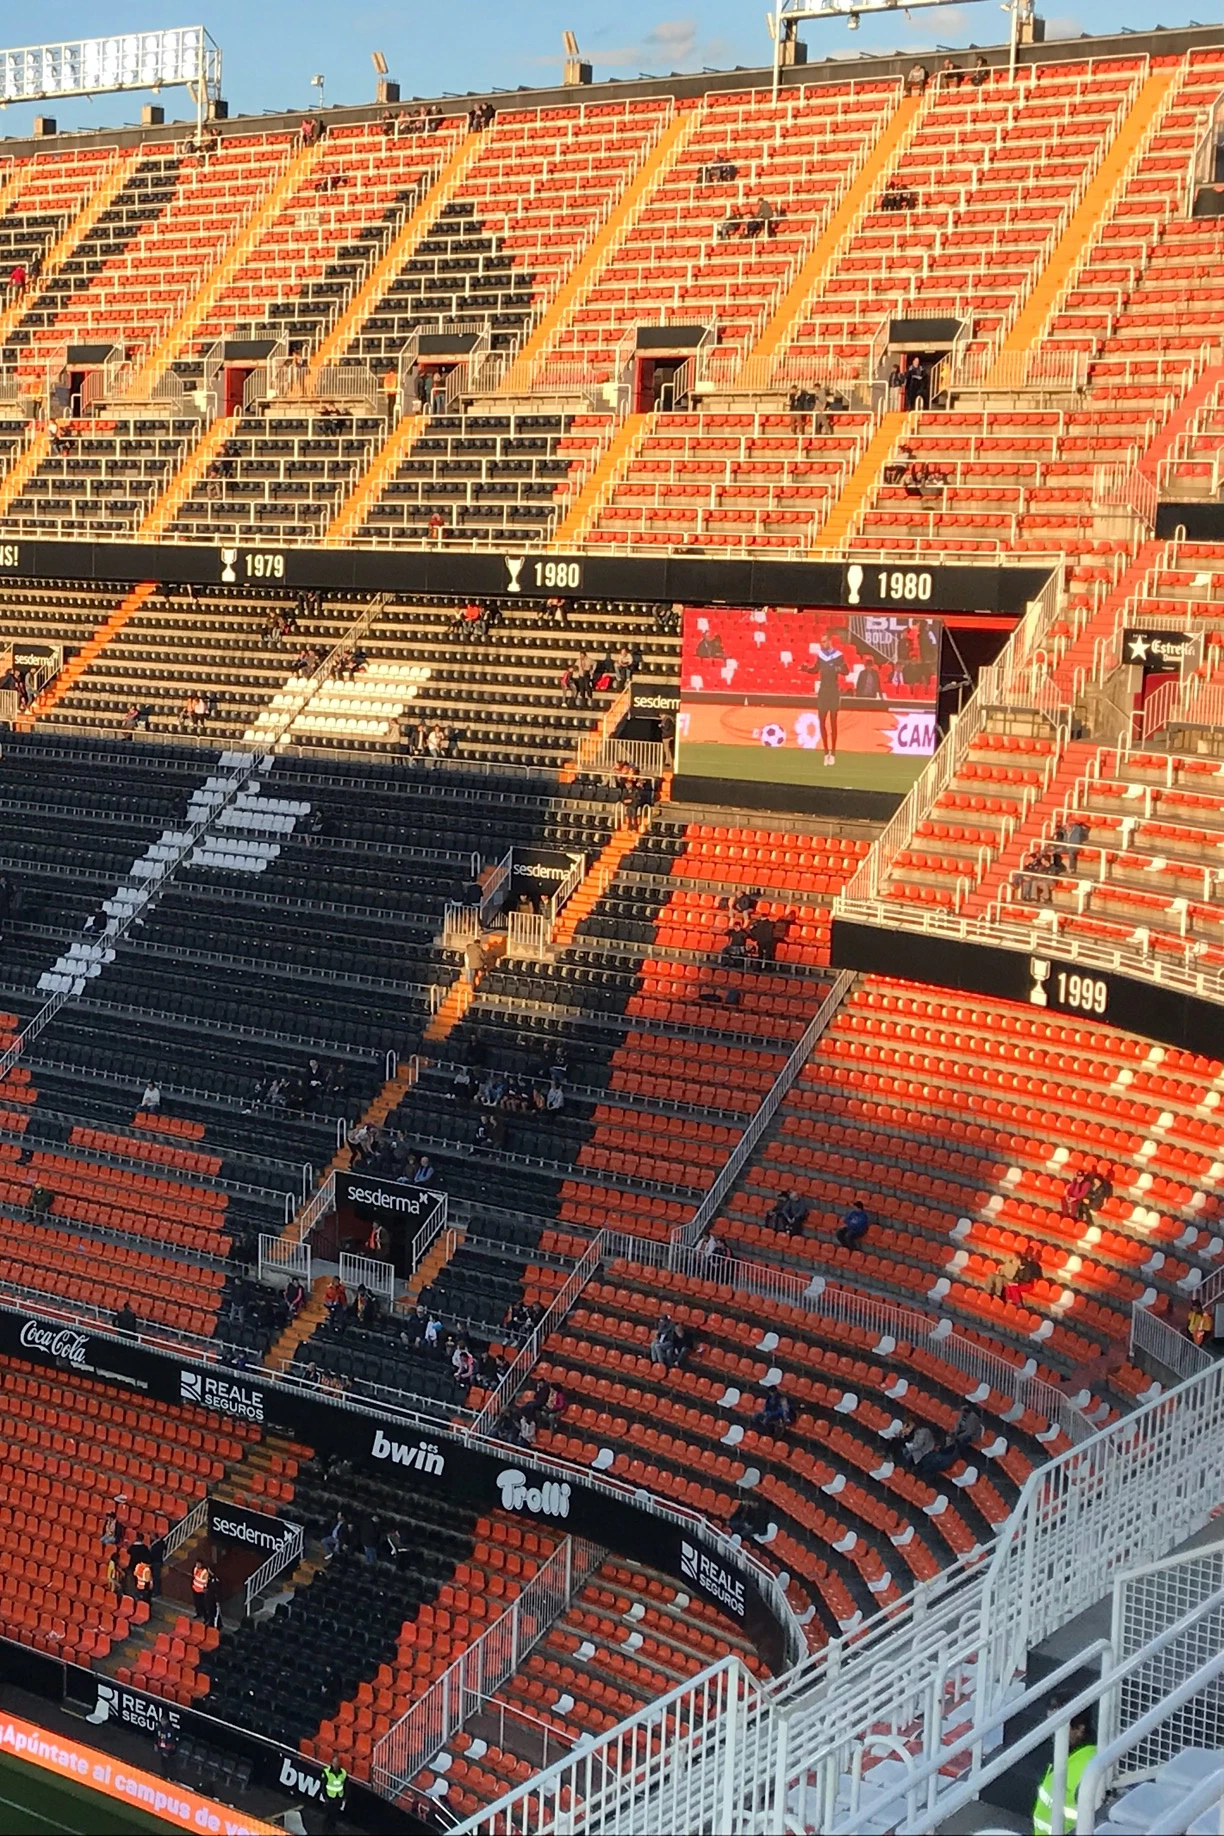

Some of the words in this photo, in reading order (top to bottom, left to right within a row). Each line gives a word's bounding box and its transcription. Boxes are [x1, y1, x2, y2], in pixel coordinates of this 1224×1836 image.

[245, 553, 284, 578] 1979
[534, 562, 579, 588] 1980
[878, 571, 932, 600] 1980
[15, 654, 55, 667] sesderma
[633, 695, 681, 710] sesderm
[513, 863, 571, 880] sesderma
[1058, 972, 1107, 1014] 1999
[348, 1186, 420, 1215] sesderma
[204, 1394, 264, 1420] SEGUROS
[205, 1378, 264, 1409] REALE
[372, 1430, 445, 1476] bwin
[496, 1469, 571, 1517] Trolli
[213, 1516, 285, 1551] sesderma
[700, 1553, 745, 1601] REALE
[699, 1574, 745, 1617] SEGUROS
[122, 1694, 180, 1730] REALE
[92, 1764, 111, 1784] al
[114, 1773, 190, 1819] campus
[195, 1800, 221, 1829] de
